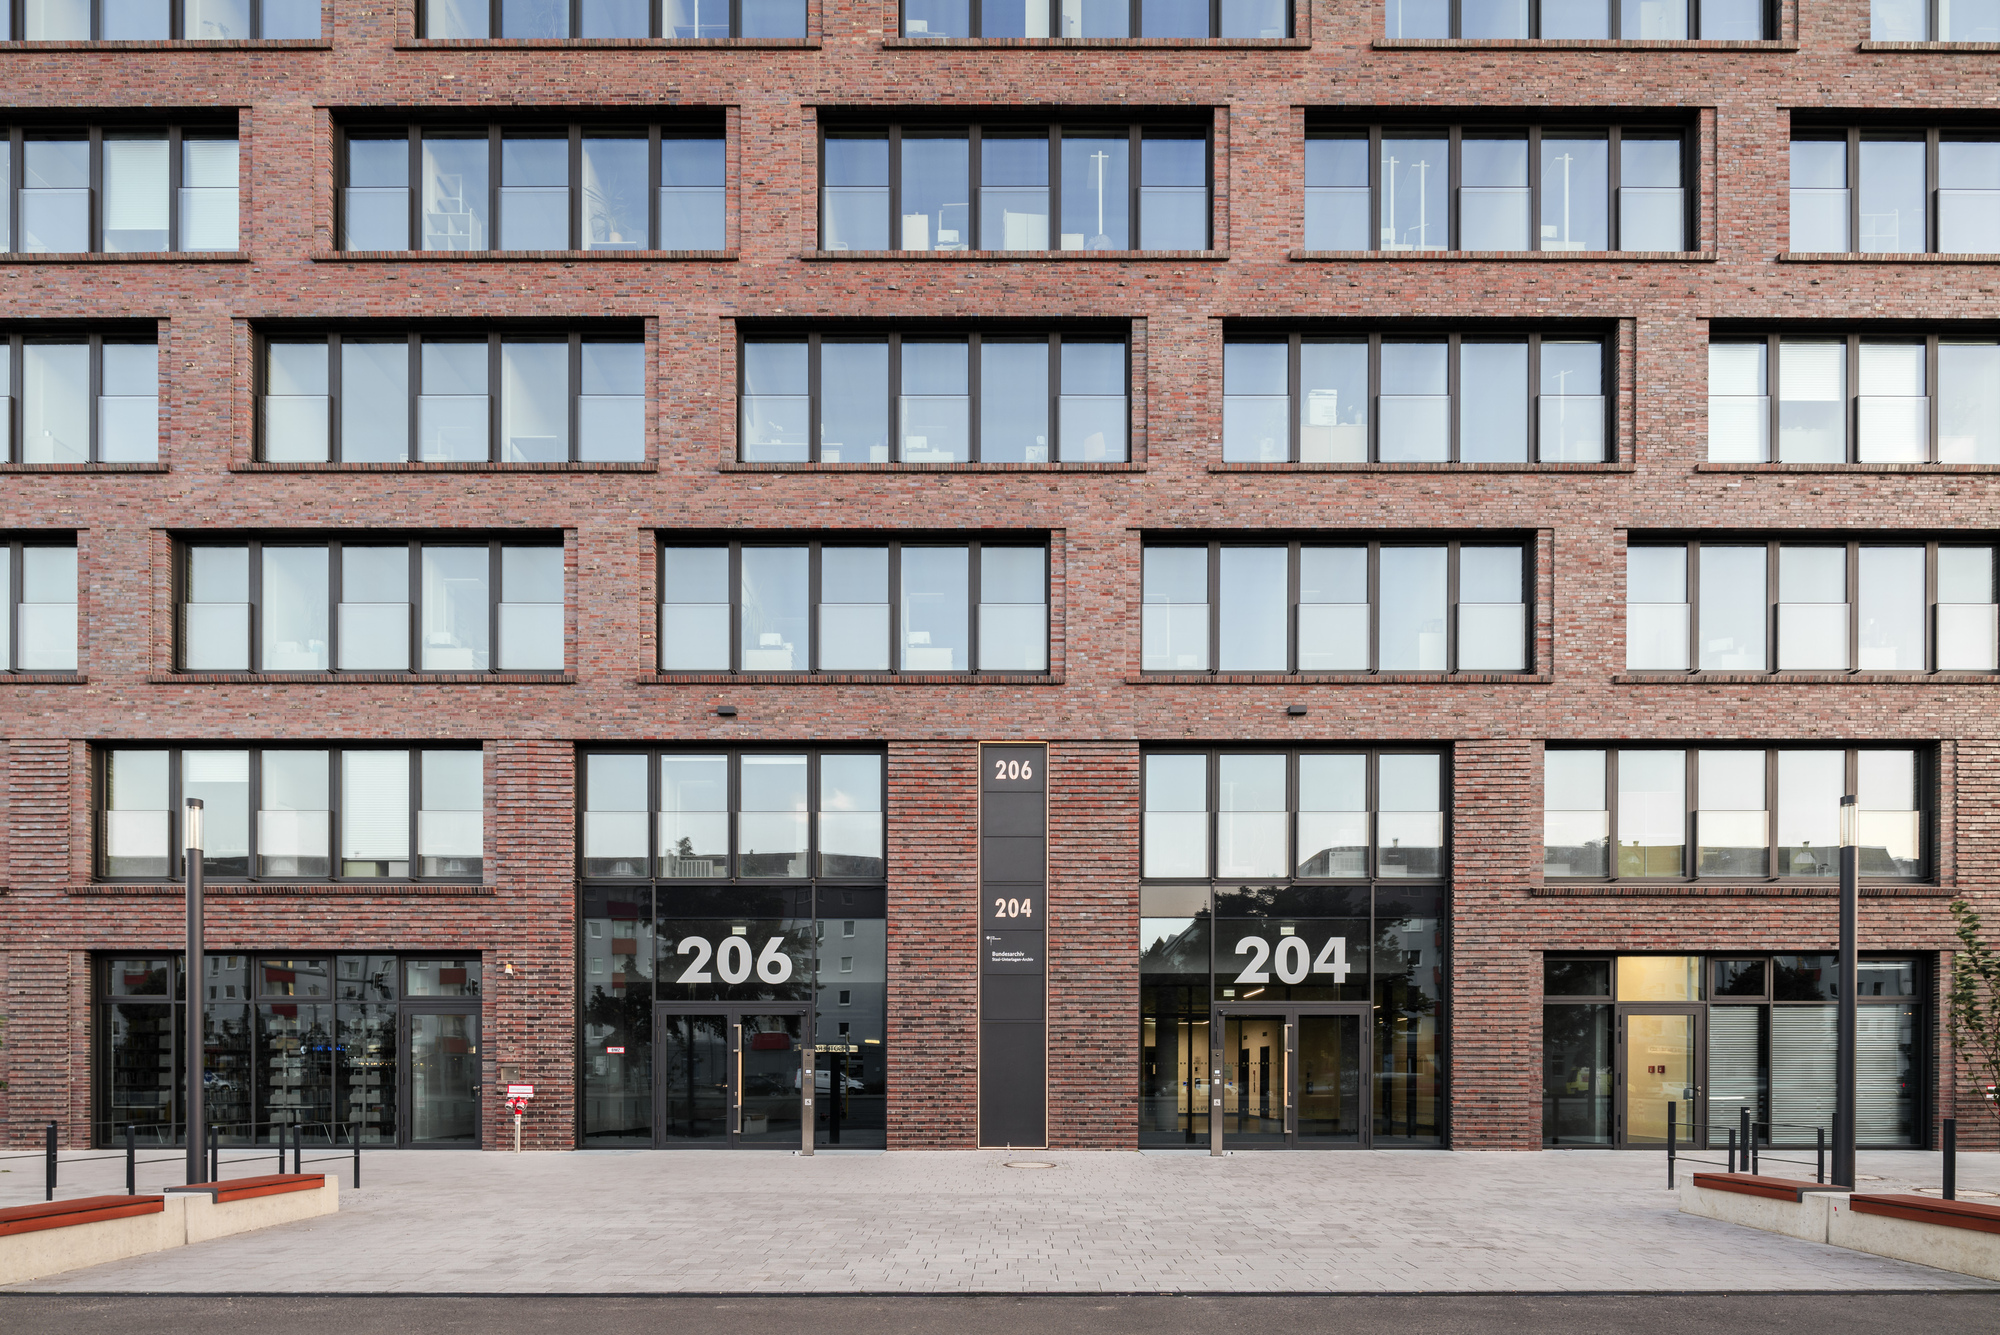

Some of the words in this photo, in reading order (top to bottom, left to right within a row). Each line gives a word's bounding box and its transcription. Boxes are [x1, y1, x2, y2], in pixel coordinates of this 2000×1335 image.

[994, 759, 1033, 781] 206
[994, 897, 1033, 919] 204
[676, 936, 793, 985] 206
[1234, 936, 1351, 985] 204
